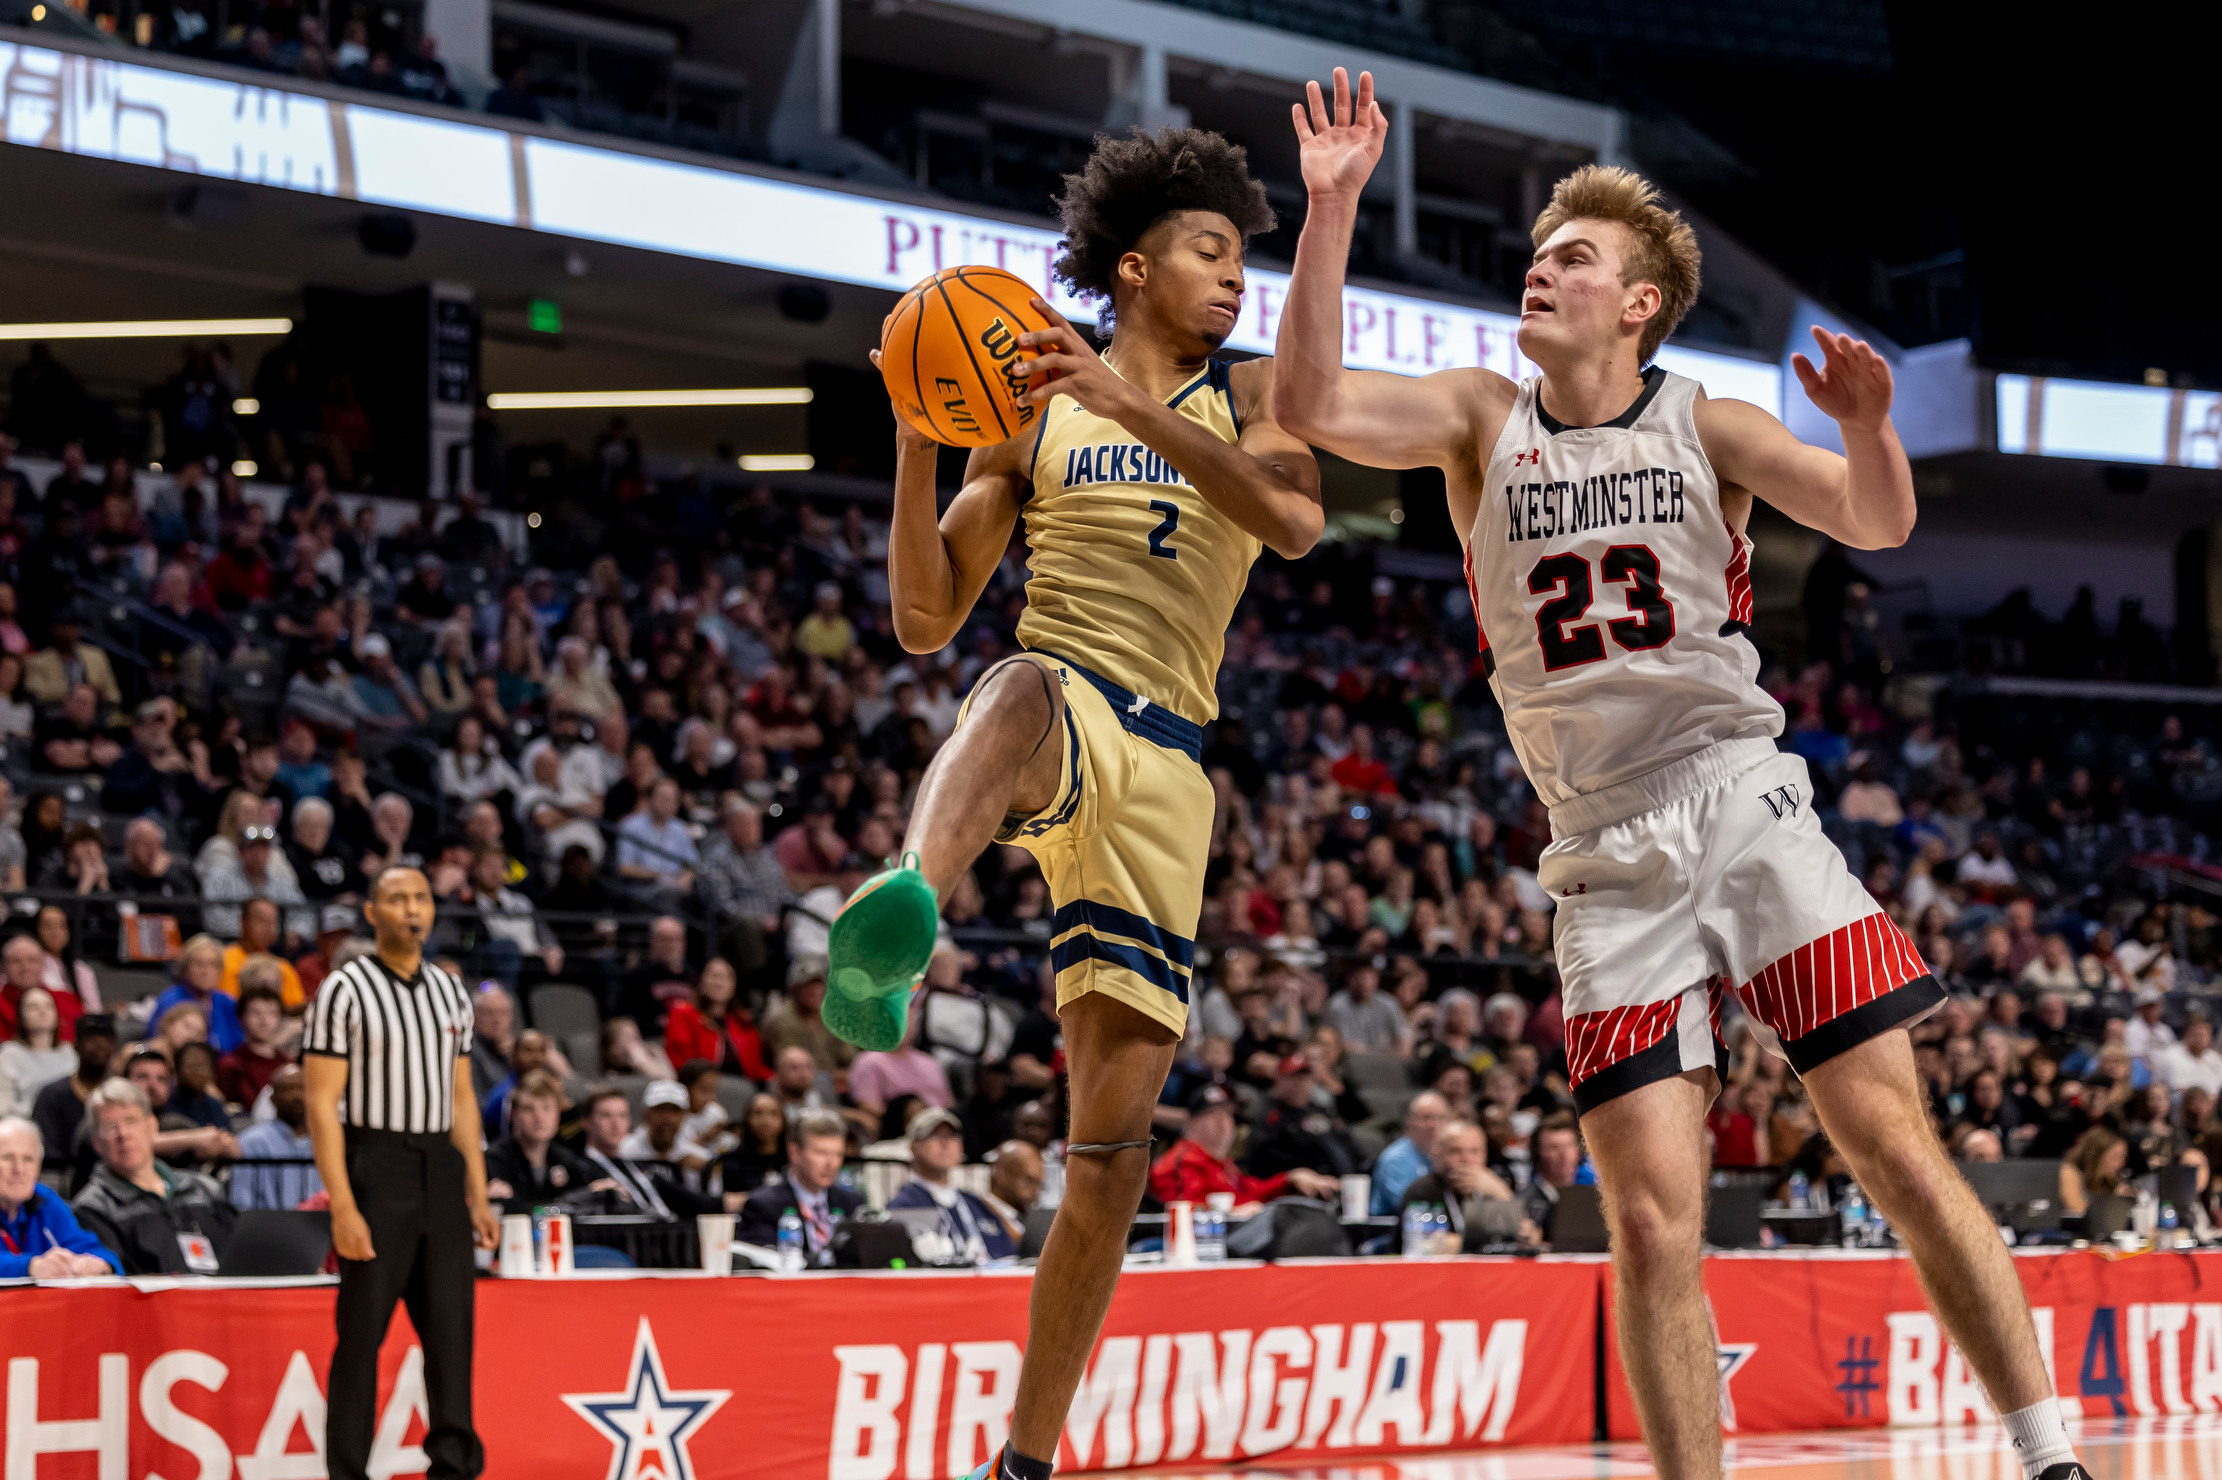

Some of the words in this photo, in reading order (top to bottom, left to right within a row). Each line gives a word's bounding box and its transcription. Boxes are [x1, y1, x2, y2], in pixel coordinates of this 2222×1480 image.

[884, 215, 1092, 307] PUTT
[1238, 284, 1454, 370] EPLE
[935, 376, 982, 432] EVO
[981, 315, 1035, 429] Wilsn
[1062, 443, 1195, 490] JACKSON
[1506, 467, 1685, 542] WESTMINSTER
[1147, 499, 1181, 561] 2
[1527, 543, 1676, 673] 23
[1757, 783, 1800, 821] W
[829, 1319, 1528, 1480] BIRMINGHAM
[1835, 1302, 2222, 1427] #BAL4ITA
